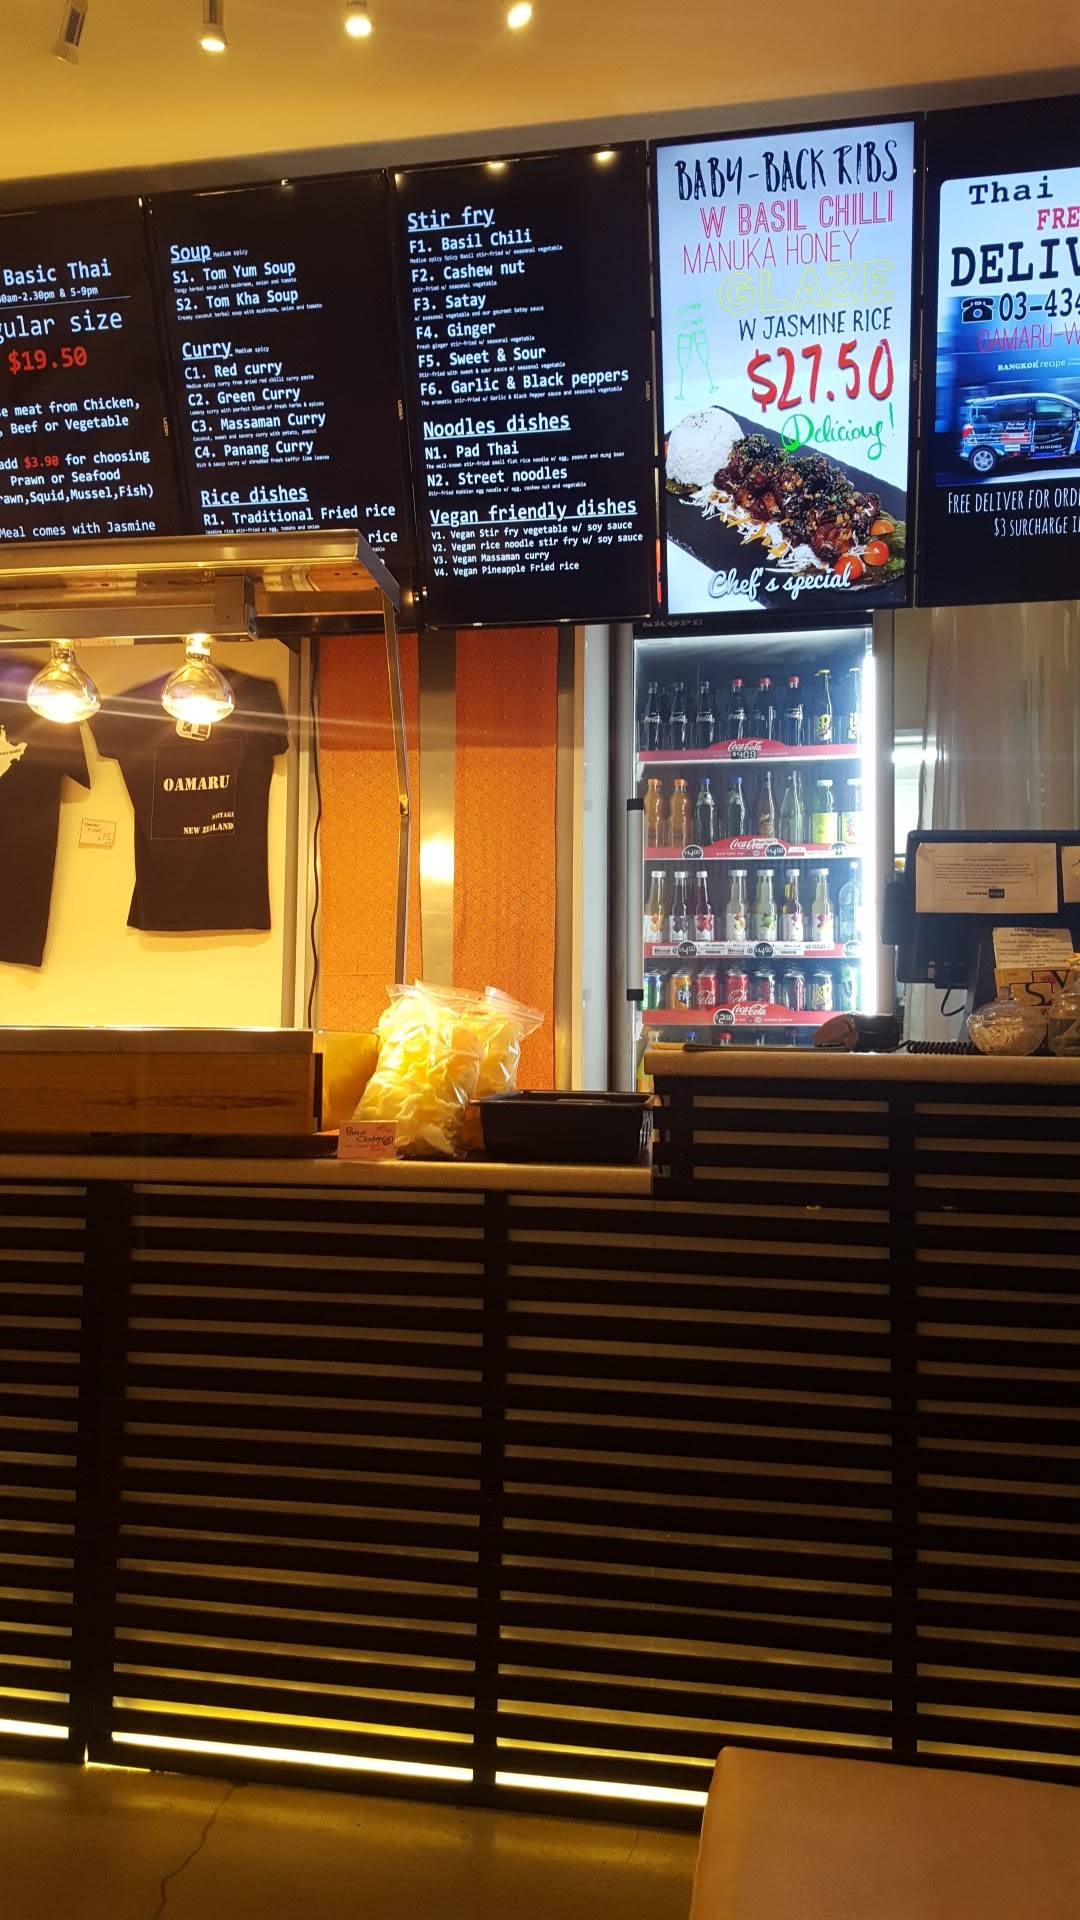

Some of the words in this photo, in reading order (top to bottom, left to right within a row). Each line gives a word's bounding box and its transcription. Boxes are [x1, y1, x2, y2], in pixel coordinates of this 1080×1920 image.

[833, 140, 898, 185] RIBS
[968, 174, 1054, 206] Thai
[408, 209, 451, 233] Stir
[461, 206, 495, 228] fry
[700, 205, 726, 239] W
[738, 198, 807, 236] BASIL
[818, 190, 893, 228] CHILLI
[410, 240, 432, 254] F1.
[442, 233, 483, 251] Basil
[490, 228, 532, 246] Chili
[170, 245, 212, 264] Soup
[683, 236, 777, 275] MANUKA
[786, 228, 860, 267] HONEY
[3, 264, 57, 286] Basic
[67, 258, 112, 279] Thai
[173, 270, 194, 284] S1.
[202, 268, 227, 281] Tom
[233, 265, 257, 278] Yum
[264, 262, 296, 277] Soup
[412, 268, 434, 283] F2.
[444, 264, 493, 280] Cashew
[500, 259, 525, 275] nut
[60, 288, 66, 298] &
[70, 287, 99, 298] 5-9pm
[718, 258, 895, 316] GLAZE
[176, 298, 198, 311] S2.
[206, 296, 230, 308] Tom
[236, 292, 260, 306] Kha
[267, 290, 299, 304] Soup
[414, 297, 436, 311] F3.
[446, 294, 486, 310] Satay
[70, 310, 122, 332] size
[738, 318, 757, 341] W
[762, 310, 846, 340] JASMINE
[853, 306, 893, 332] RICE
[416, 326, 438, 340] F4.
[447, 323, 496, 338] Ginger
[8, 346, 88, 375] $19.50
[182, 342, 233, 361] Curry
[418, 354, 440, 368] F5.
[450, 350, 490, 366] Sweet
[497, 349, 507, 362] &
[513, 348, 546, 361] Sour
[185, 367, 206, 380] C1.
[214, 364, 238, 378] Red
[244, 362, 282, 377] curry
[747, 338, 894, 413] $27.50
[998, 360, 1040, 372] BANGKOK
[1040, 359, 1066, 369] recipe
[420, 382, 442, 396] F6.
[451, 377, 499, 394] Garlic
[507, 376, 516, 390] &
[523, 373, 564, 389] Black
[572, 370, 629, 388] peppers
[14, 403, 43, 416] meat
[49, 401, 78, 413] from
[84, 397, 140, 411] Chicken,
[188, 393, 209, 406] C2.
[217, 391, 256, 404] Green
[262, 388, 300, 402] Curry
[10, 420, 38, 434] Beef
[45, 422, 59, 432] or
[64, 414, 129, 432] Vegetable
[192, 420, 213, 433] C3.
[220, 416, 281, 431] Massaman
[288, 413, 326, 427] Curry
[424, 418, 496, 440] Noodles
[506, 414, 571, 435] dishes
[24, 456, 59, 469] $3.90
[65, 453, 86, 466] for
[93, 450, 150, 464] choosing
[195, 446, 216, 459] C4.
[224, 444, 270, 458] Panang
[276, 441, 314, 457] Curry
[425, 446, 447, 460] N1.
[456, 443, 480, 458] Pad
[487, 440, 519, 456] Thai
[10, 476, 45, 486] Prawn
[51, 474, 65, 484] or
[71, 468, 121, 483] Seafood
[427, 474, 449, 487] N2.
[458, 470, 505, 485] Street
[513, 467, 568, 482] noodles
[201, 488, 240, 508] Rice
[250, 485, 309, 506] dishes
[948, 492, 971, 514] FREE
[975, 490, 1024, 513] DELIVER
[1028, 489, 1050, 510] FOR
[203, 513, 224, 526] R1.
[232, 508, 314, 524] Traditional
[321, 506, 358, 520] Fried
[366, 504, 396, 517] rice
[430, 509, 478, 527] Vegan
[488, 502, 567, 524] friendly
[577, 499, 638, 519] dishes
[0, 526, 26, 538] Meal
[32, 526, 66, 537] comes
[72, 522, 101, 535] with
[107, 520, 156, 533] Jasmine
[368, 530, 398, 543] rice
[431, 531, 446, 540] V1.
[450, 530, 475, 540] Vegan
[479, 528, 499, 538] Stir
[504, 527, 519, 538] fry
[523, 524, 568, 537] vegetable
[572, 523, 582, 533] w/
[588, 523, 603, 533] soy
[607, 522, 633, 530] sauce
[994, 517, 1007, 537] $3
[1009, 516, 1069, 537] SURCHARGE
[432, 544, 447, 552] V2.
[451, 543, 476, 552] Vegan
[480, 540, 500, 550] rice
[504, 538, 534, 549] noodle
[538, 537, 559, 547] stir
[563, 536, 579, 547] fry
[582, 535, 593, 545] w/
[598, 536, 613, 545] soy
[618, 534, 643, 543] sauce
[433, 556, 448, 564] V3.
[452, 555, 477, 565] Vegan
[481, 553, 521, 562] Massaman
[524, 552, 550, 561] curry
[434, 568, 448, 577] V4.
[453, 567, 478, 577] Vegan
[482, 564, 526, 575] Pineapple
[530, 562, 555, 572] Fried
[560, 561, 579, 570] rice
[708, 568, 780, 599] Chef's
[783, 562, 852, 600] special
[164, 774, 231, 792] OAMARU
[183, 826, 201, 835] NEW
[732, 1004, 767, 1016] Coca-Cola
